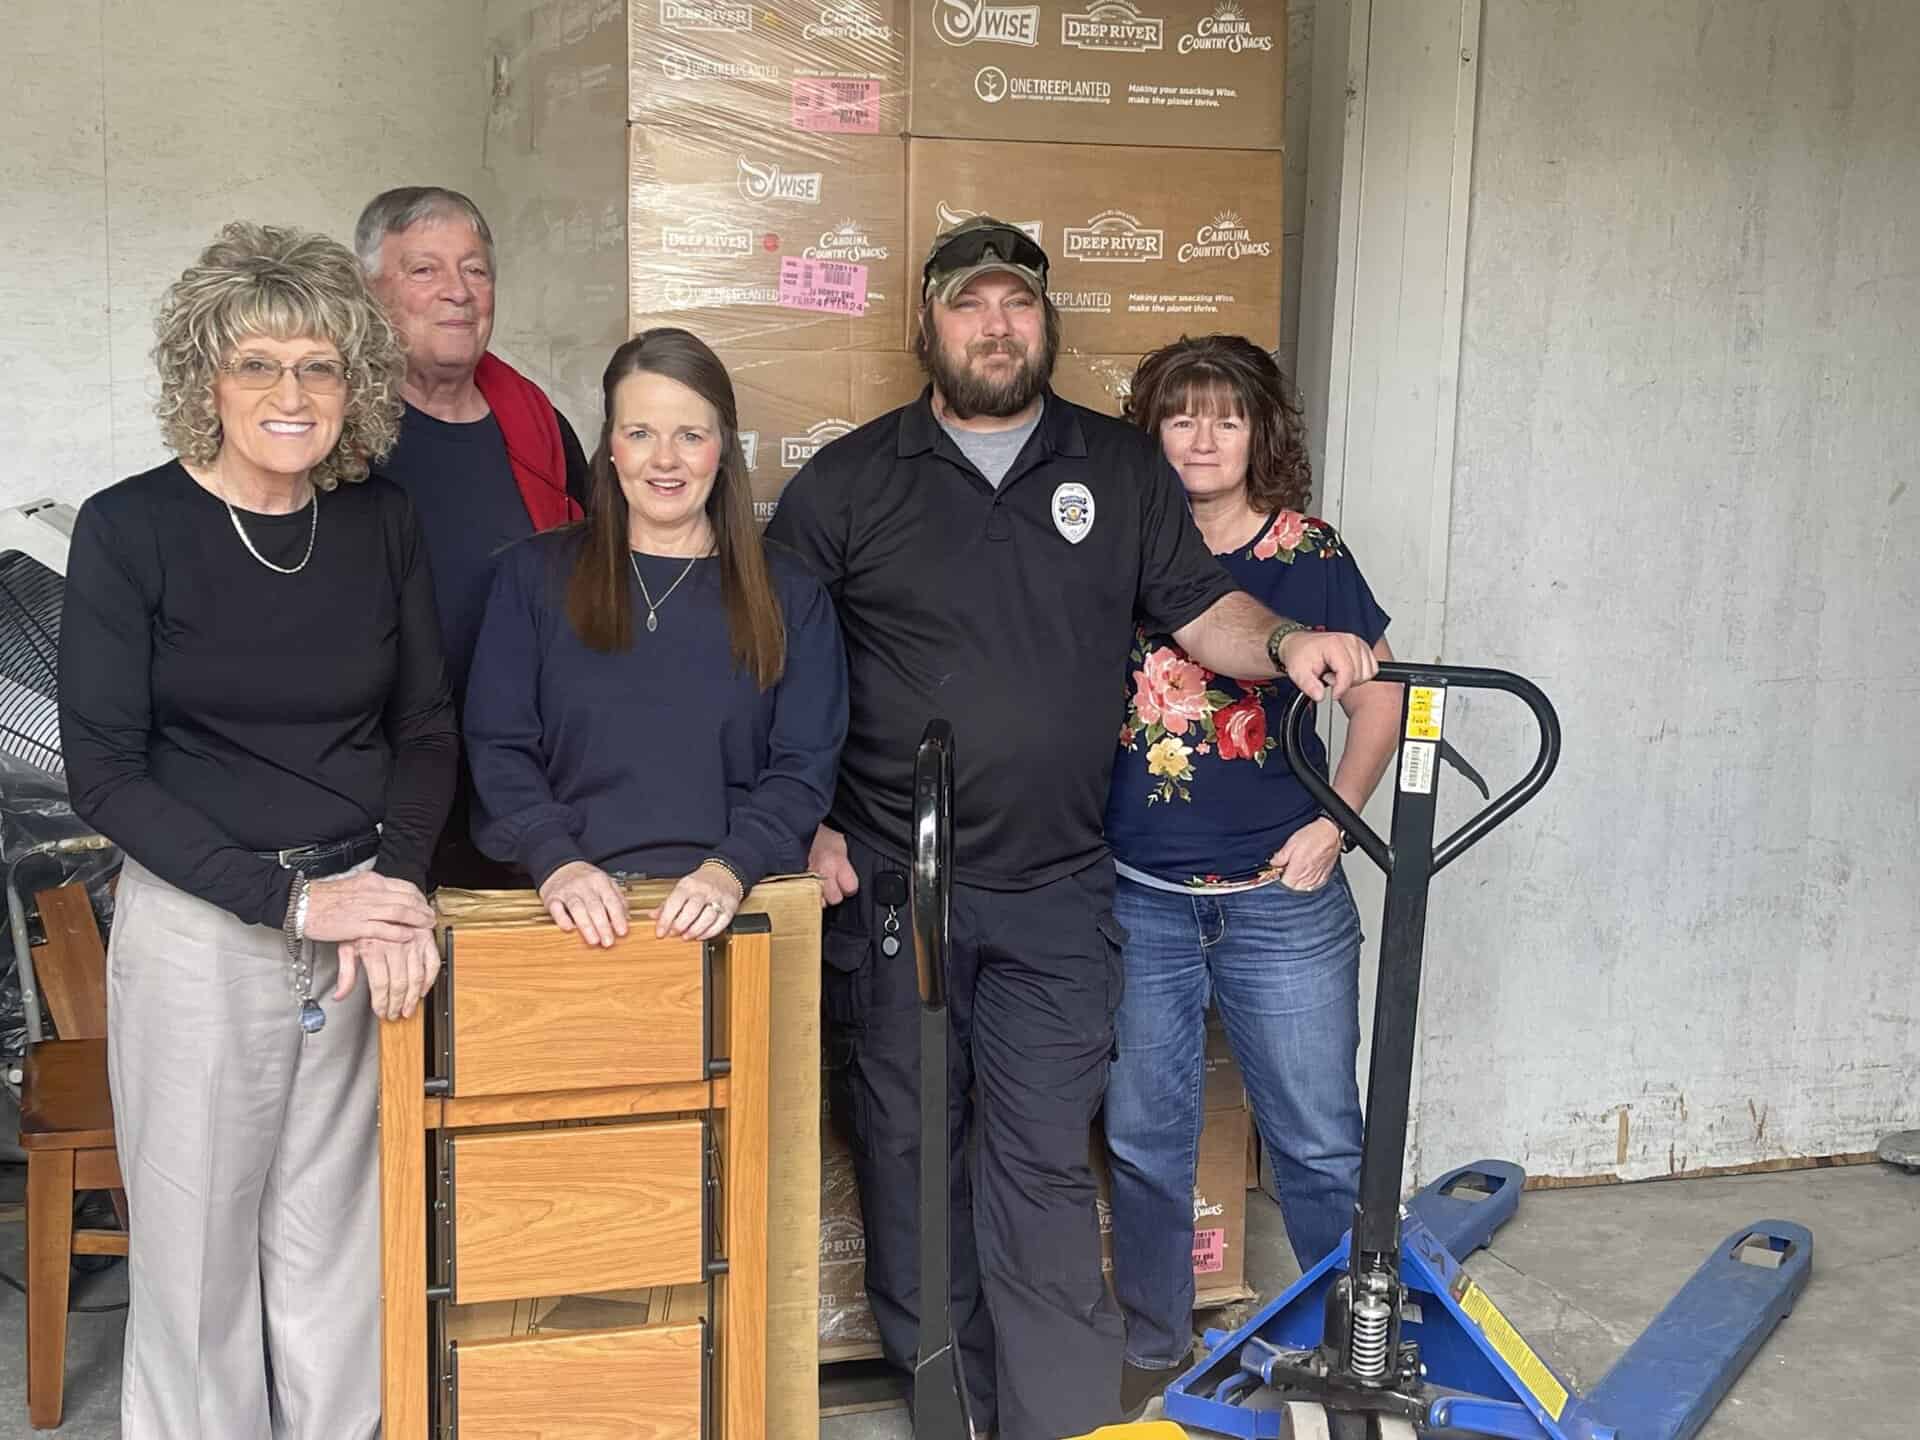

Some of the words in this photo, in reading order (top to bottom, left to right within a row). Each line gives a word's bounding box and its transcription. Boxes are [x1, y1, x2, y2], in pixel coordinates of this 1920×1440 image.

[984, 10, 1033, 39] WISE
[1067, 21, 1108, 38] DEEP
[1110, 25, 1158, 41] RIVER
[1197, 17, 1252, 37] CAROLINA
[1177, 34, 1228, 54] COUNTRY
[1226, 33, 1273, 53] SNACKS
[1010, 79, 1112, 97] ONETREEPLANTED
[779, 175, 816, 198] WISE
[1069, 235, 1109, 250] DEEP
[1110, 236, 1158, 252] RIVER
[1197, 225, 1251, 245] CAROLINA
[1177, 243, 1228, 263] COUNTRY
[1226, 241, 1272, 260] SNACKS
[1047, 291, 1112, 306] EEPLANTED
